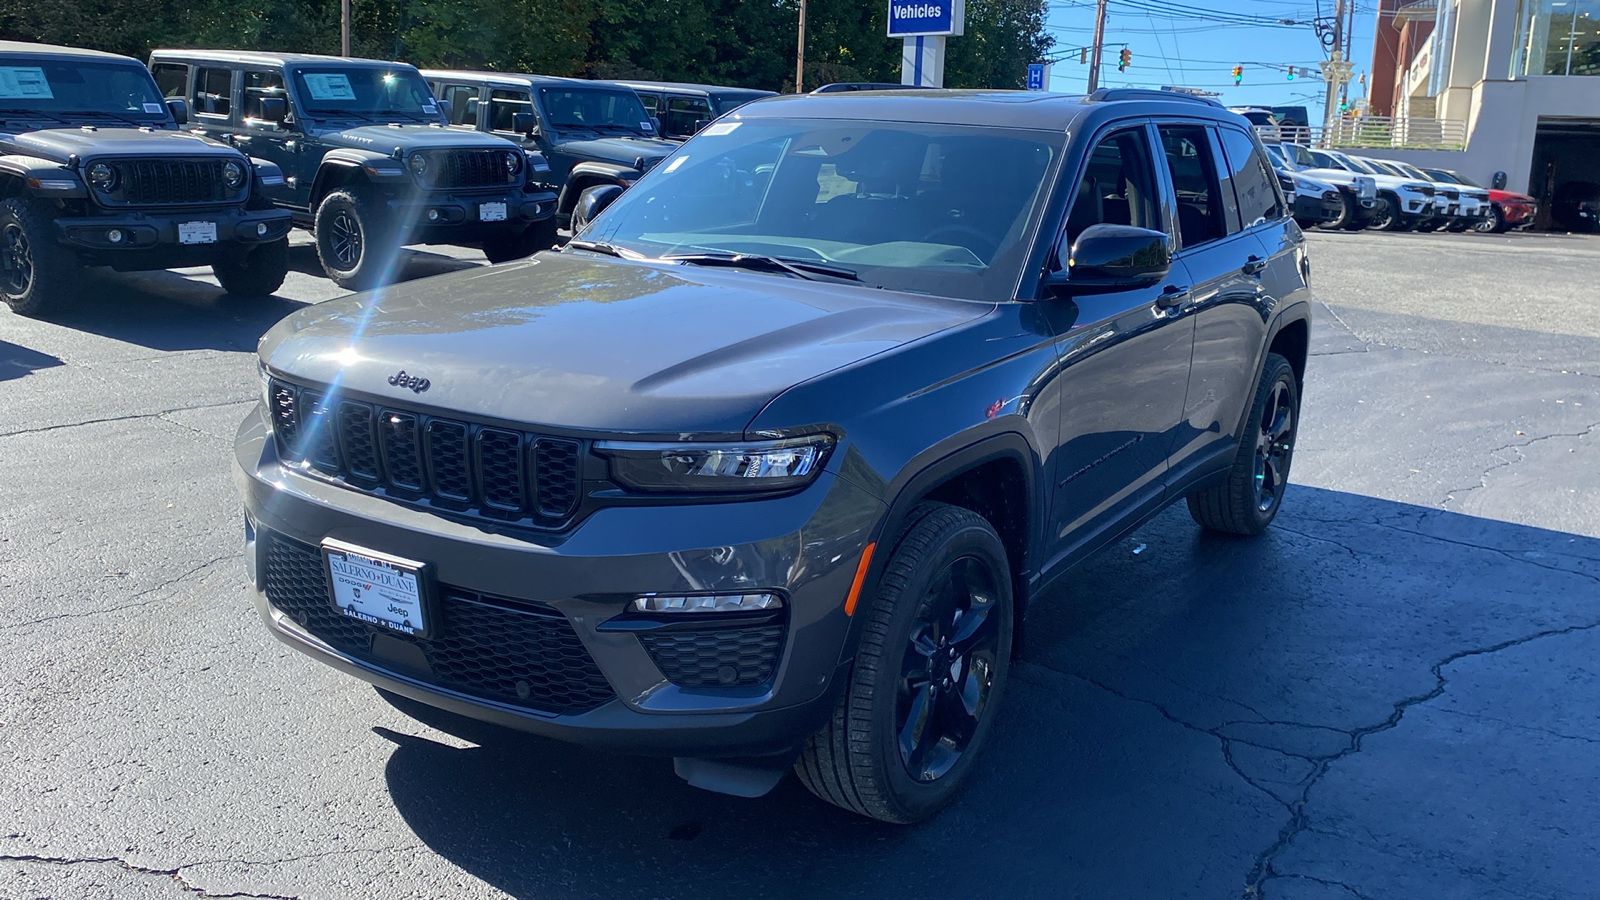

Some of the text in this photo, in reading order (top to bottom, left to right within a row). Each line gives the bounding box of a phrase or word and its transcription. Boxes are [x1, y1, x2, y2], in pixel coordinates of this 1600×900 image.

[893, 4, 941, 19] Vehicles
[1031, 70, 1040, 82] H
[388, 369, 431, 394] Jeep
[332, 561, 416, 593] SALERNO DUANE
[387, 603, 409, 618] Jeep
[343, 608, 414, 635] SALERNO DUANE
